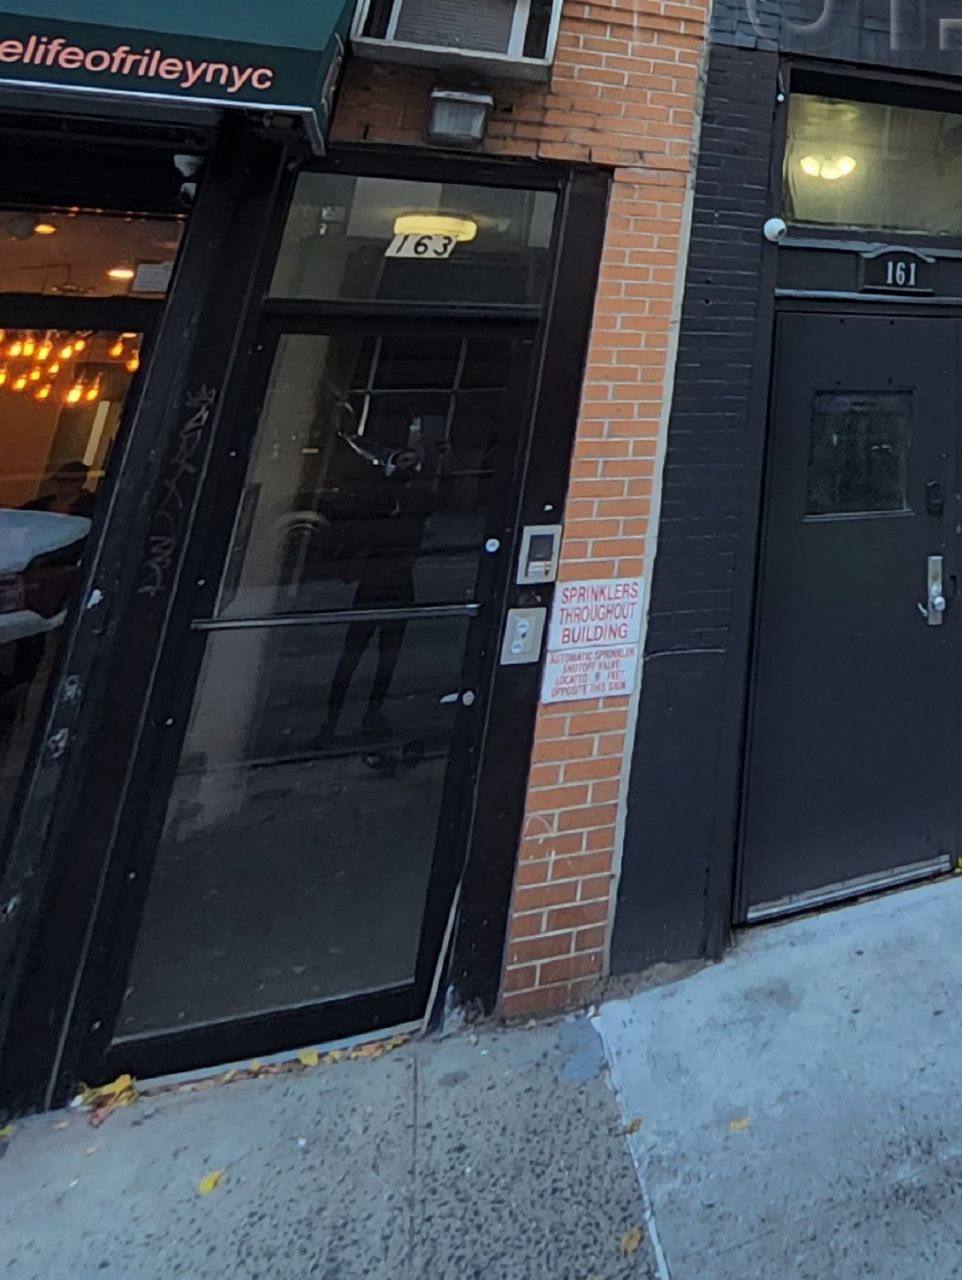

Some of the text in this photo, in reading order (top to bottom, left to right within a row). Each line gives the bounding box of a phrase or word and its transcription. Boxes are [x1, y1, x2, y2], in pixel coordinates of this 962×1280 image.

[396, 234, 453, 256] 163
[886, 261, 916, 286] 161
[562, 582, 639, 604] SPRINKLERS
[560, 602, 638, 625] THROUGHOUT
[561, 623, 628, 645] BUILDING
[550, 646, 635, 665] AUTOMATIC SPRINKLER
[607, 670, 625, 681] FEET
[551, 681, 625, 698] OPPOSITE THIS SIGN
